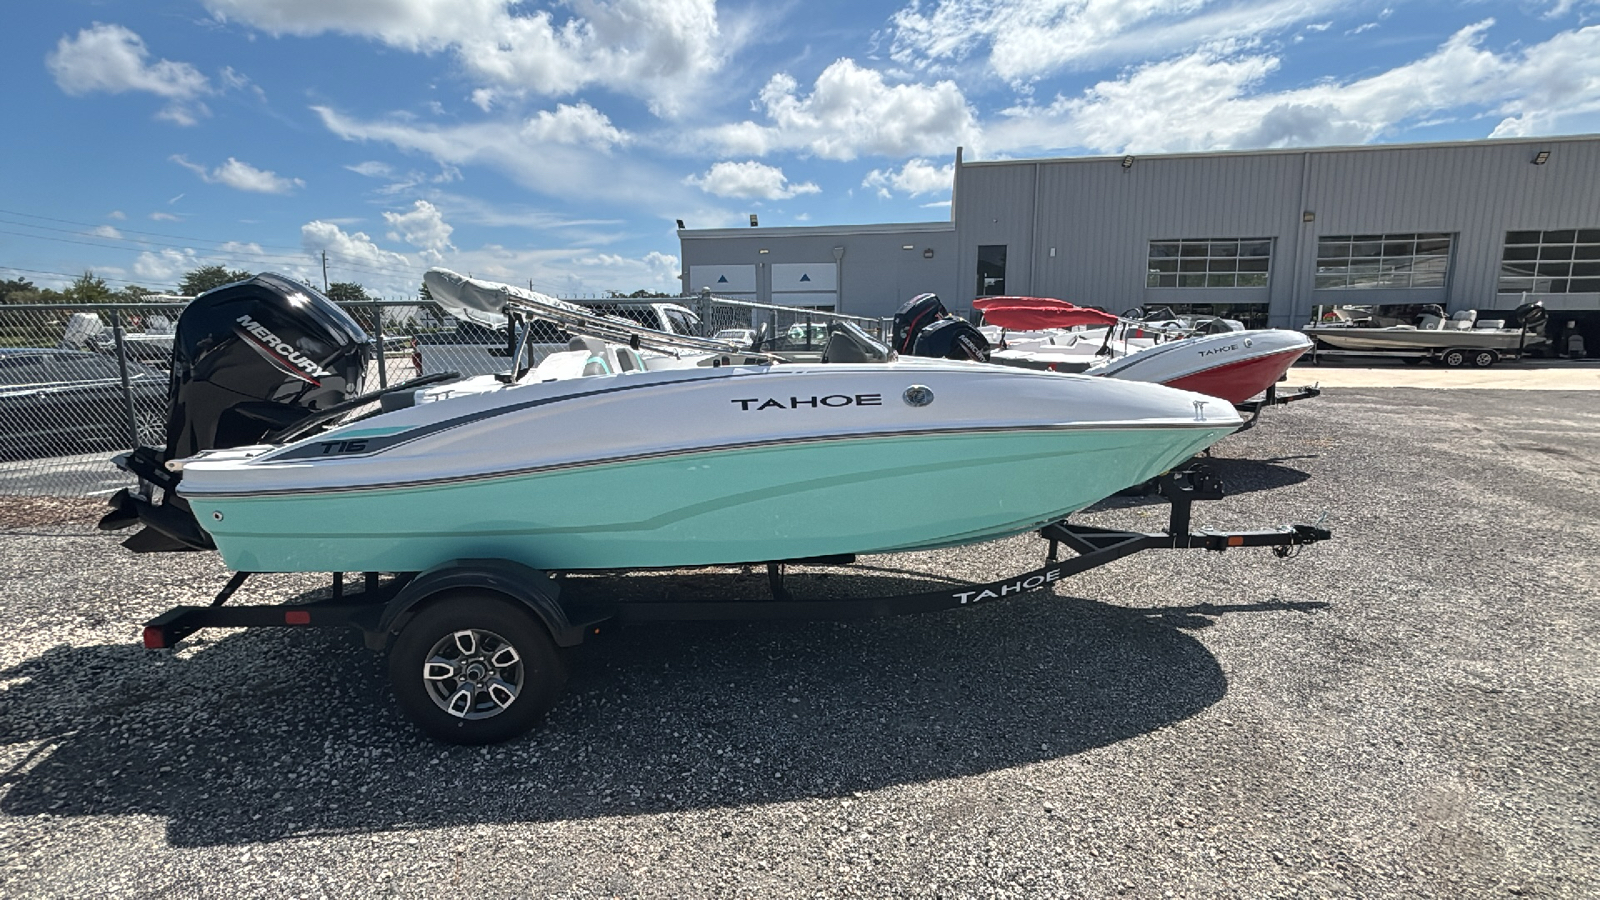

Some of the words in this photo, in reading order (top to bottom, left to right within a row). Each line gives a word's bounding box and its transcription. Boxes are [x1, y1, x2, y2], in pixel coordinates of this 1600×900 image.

[236, 314, 332, 377] MERCURY
[958, 334, 987, 363] MERCURY
[1198, 344, 1238, 357] TAHOE
[731, 393, 882, 411] TAHOE
[321, 440, 369, 454] T16
[952, 568, 1061, 604] TAHOE
